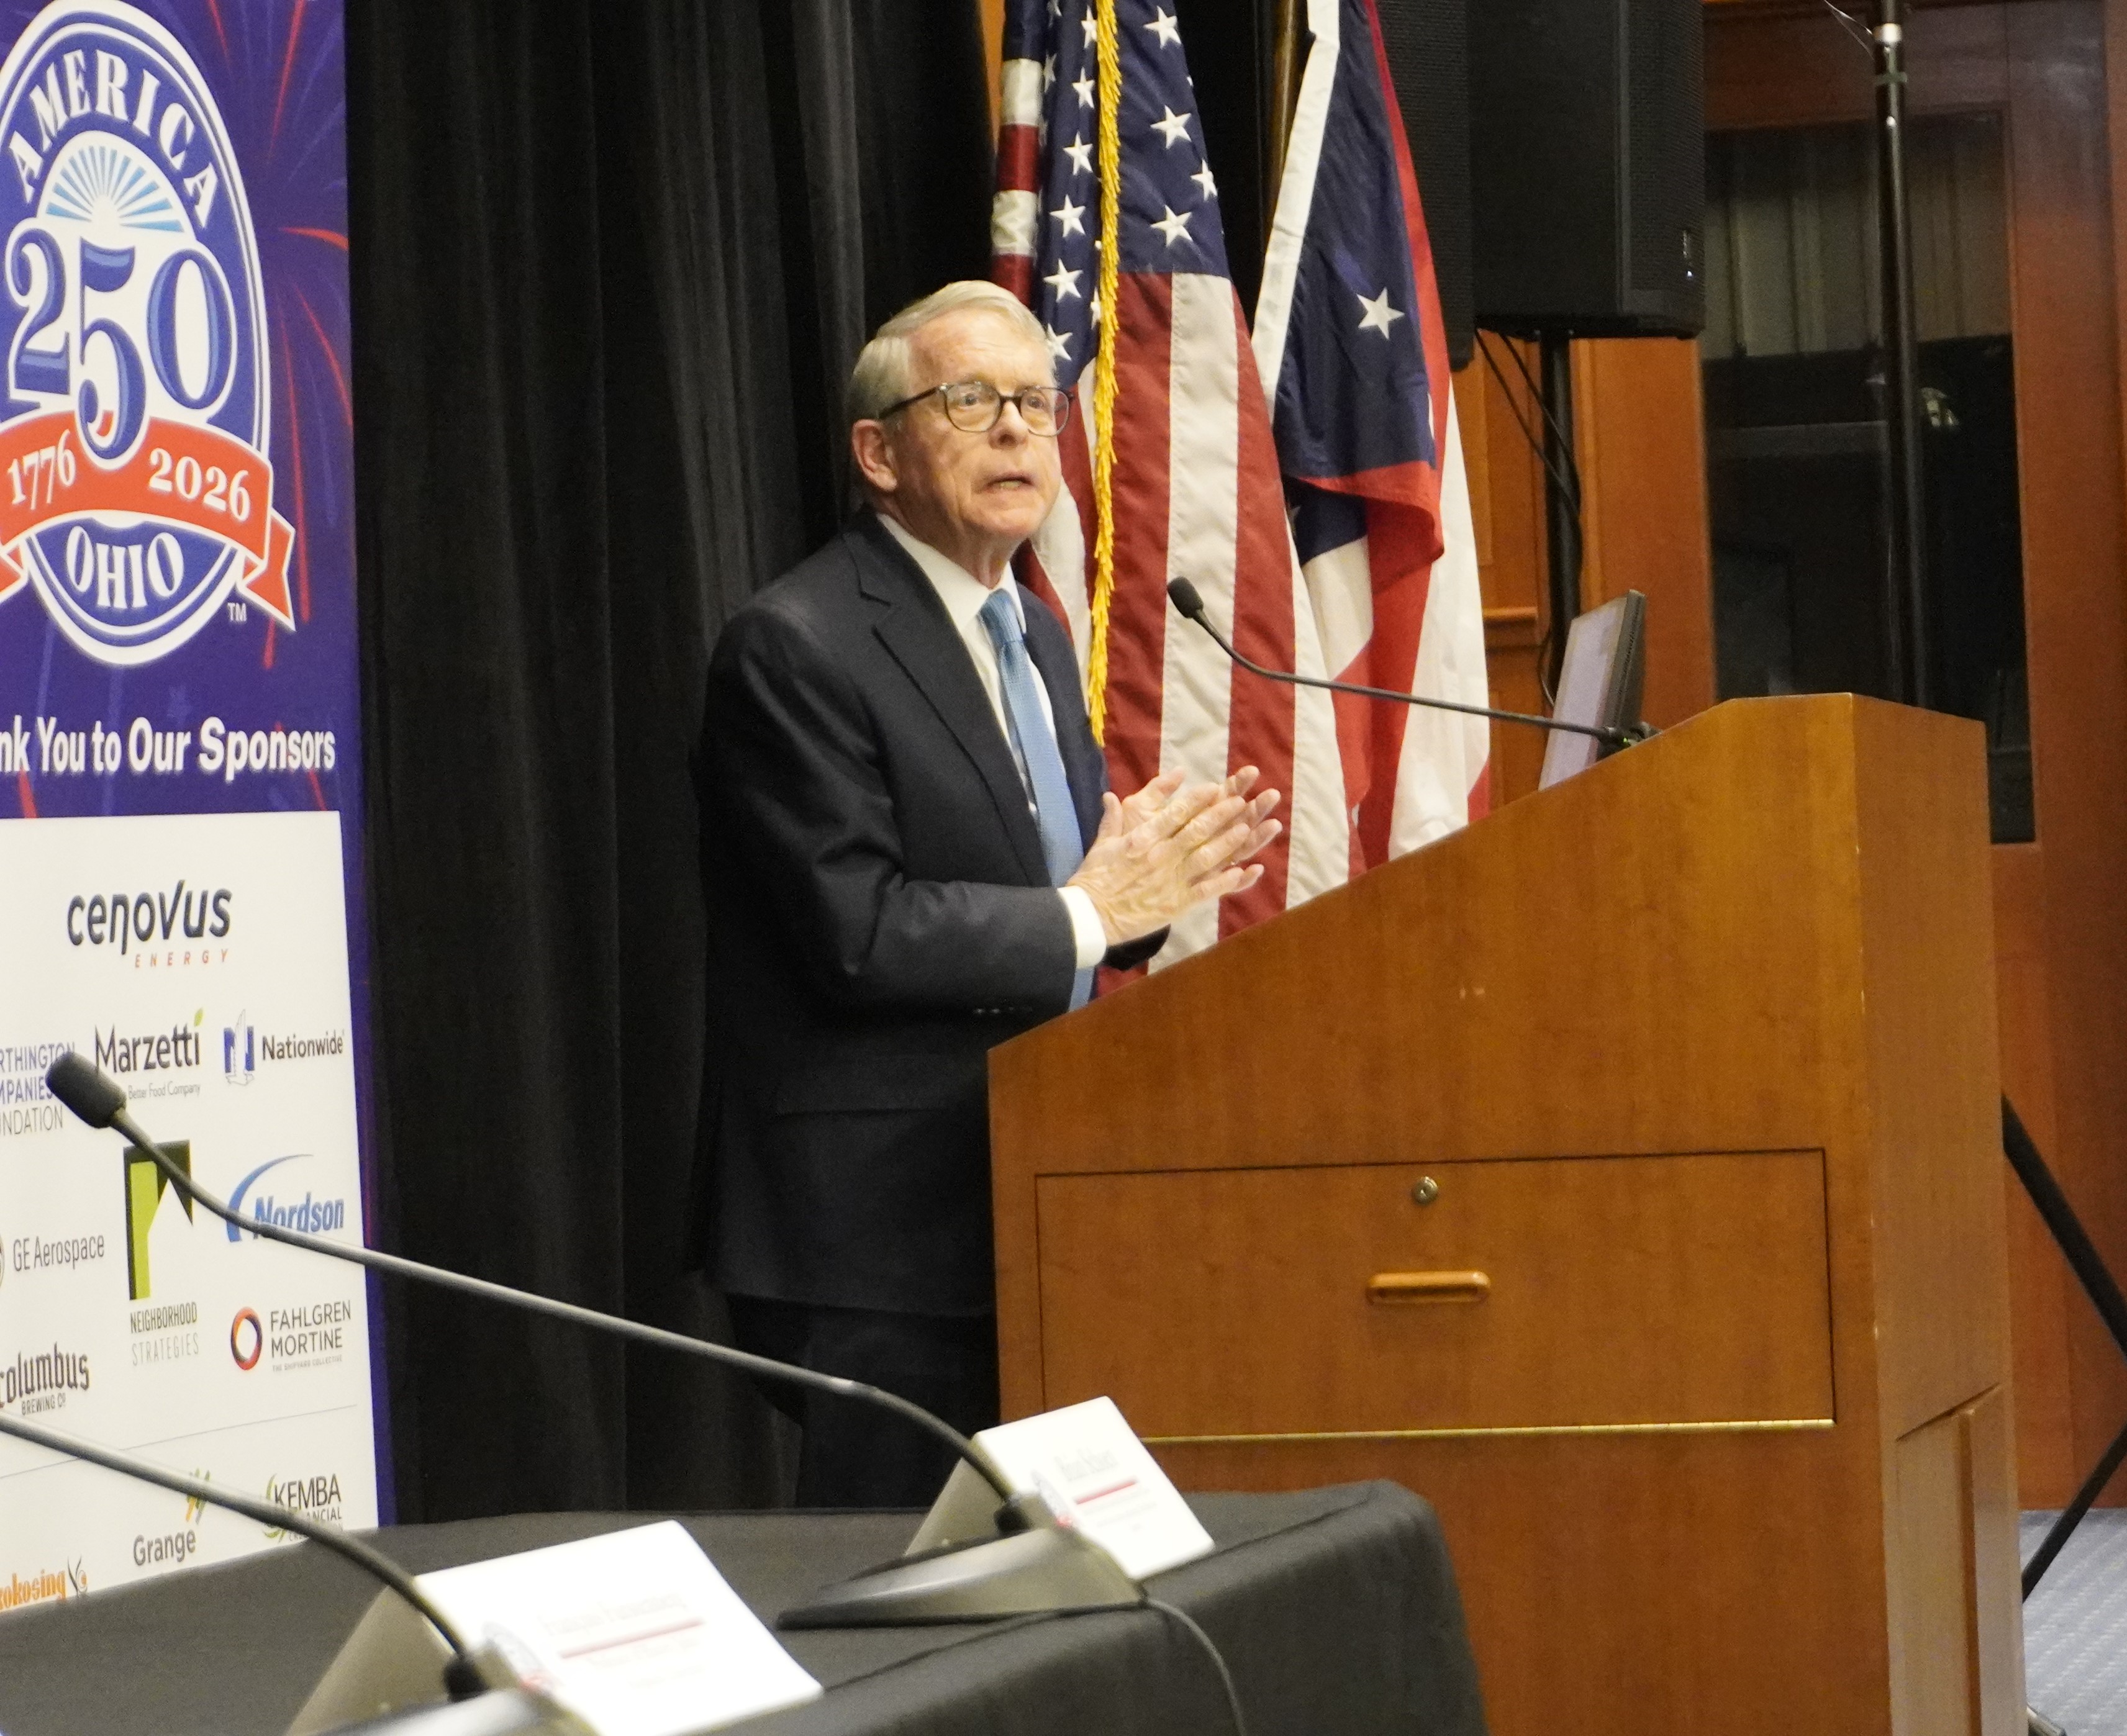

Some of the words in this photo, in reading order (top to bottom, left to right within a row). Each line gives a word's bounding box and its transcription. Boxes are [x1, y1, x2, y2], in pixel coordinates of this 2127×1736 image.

[9, 49, 218, 228] AMERICA
[9, 227, 233, 458] 250
[7, 429, 76, 510] 1776
[149, 448, 250, 522] 2026
[66, 526, 184, 607] OHIO
[227, 603, 247, 622] TM
[0, 714, 31, 772] nk
[36, 716, 86, 772] You
[93, 720, 122, 772] to
[129, 717, 191, 772] Our
[199, 716, 336, 782] Sponsors
[66, 879, 232, 955] cenovus
[135, 948, 229, 969] ENERGY
[95, 1007, 203, 1074] Marzetti
[262, 1030, 343, 1060] Nationwide
[149, 1083, 166, 1097] Food
[168, 1080, 200, 1096] Company
[253, 1191, 344, 1238] Nordson
[13, 1237, 30, 1272] GE
[34, 1234, 104, 1269] Aerospace
[130, 1301, 197, 1334] NEIGHBORHOOD
[270, 1300, 351, 1332] FAHLGREN
[132, 1332, 199, 1366] STRATEGIES
[271, 1327, 343, 1359] MORTINE
[22, 1395, 55, 1416] BREWING
[274, 1473, 341, 1510] KEMBA
[133, 1529, 196, 1566] Grange
